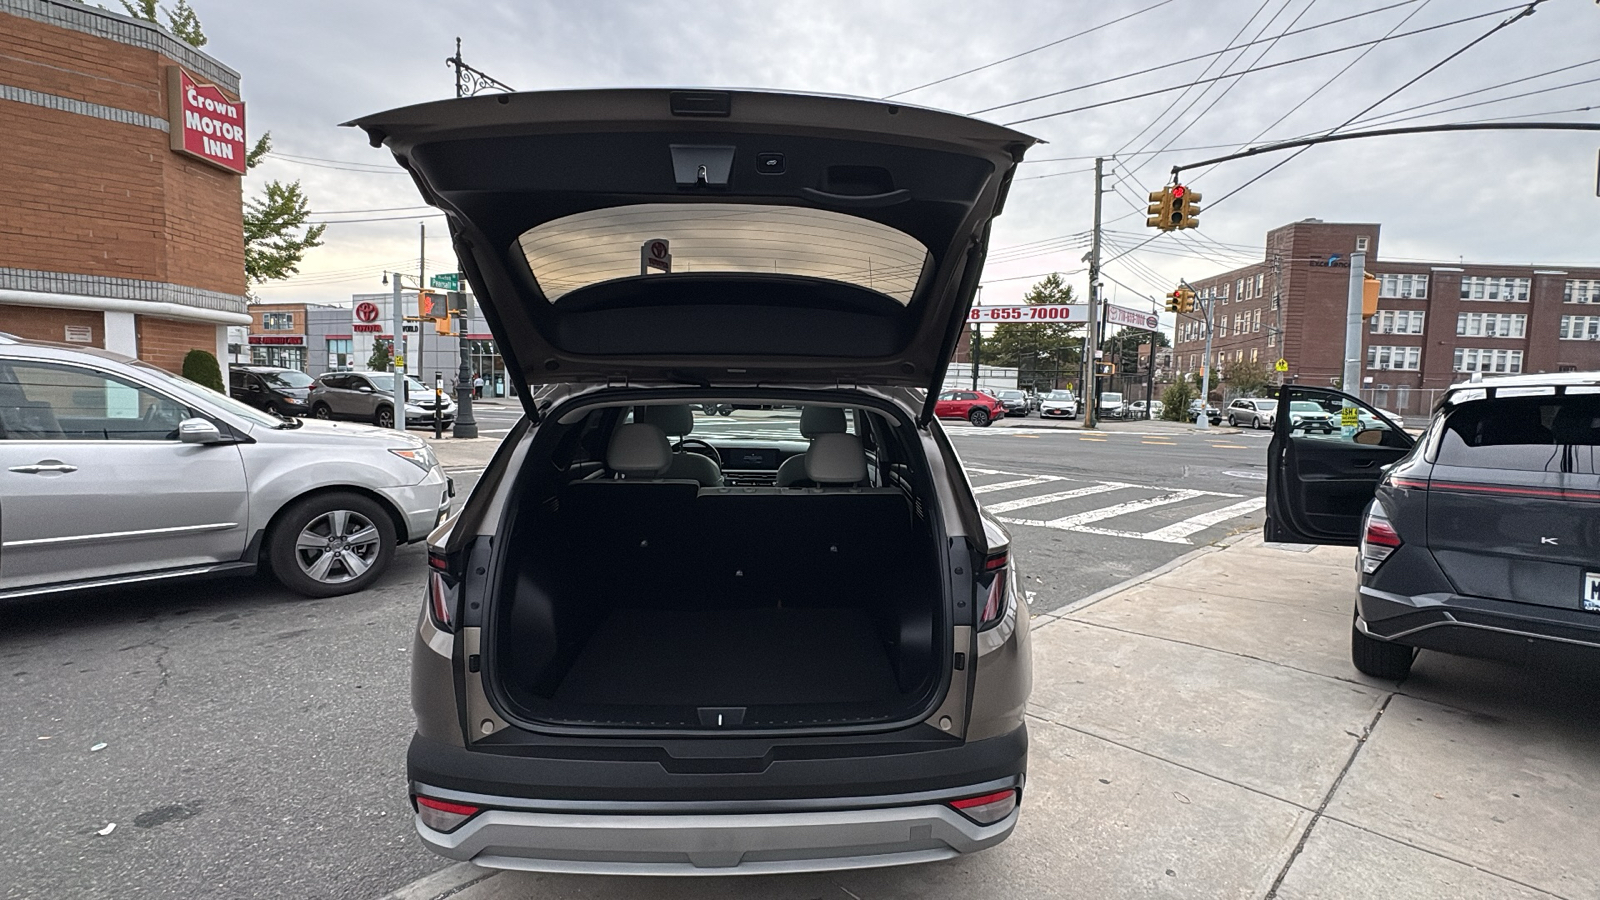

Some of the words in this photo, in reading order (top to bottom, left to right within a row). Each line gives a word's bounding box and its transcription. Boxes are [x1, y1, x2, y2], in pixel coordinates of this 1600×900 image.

[187, 88, 237, 118] Crown
[186, 110, 244, 143] MOTOR
[203, 136, 233, 160] INN
[968, 308, 1070, 320] 8-655-7000
[352, 324, 383, 333] TOYOTA
[402, 325, 418, 333] WORLD
